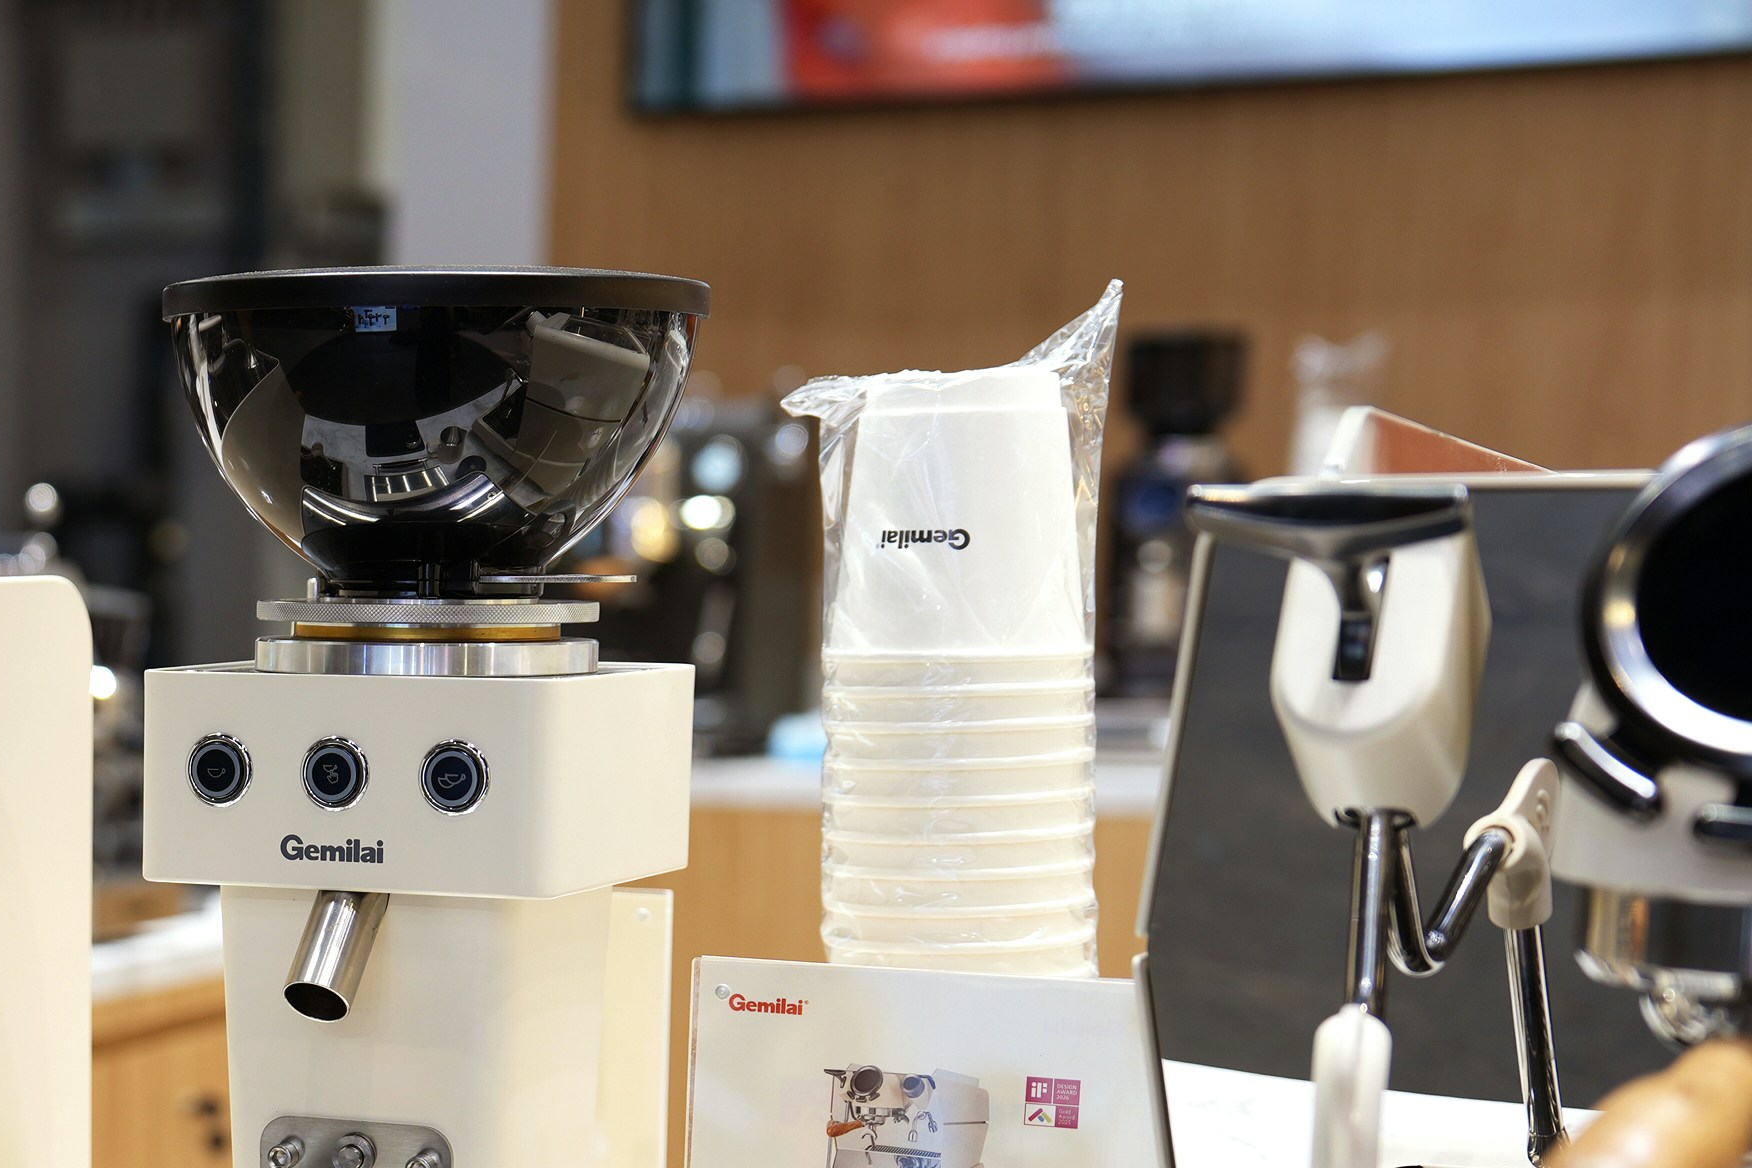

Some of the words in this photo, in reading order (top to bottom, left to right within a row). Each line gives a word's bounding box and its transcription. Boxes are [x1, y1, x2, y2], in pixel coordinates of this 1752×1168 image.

[881, 528, 970, 550] Gemilai
[280, 834, 384, 864] Gemilai
[729, 993, 803, 1015] Gemilai
